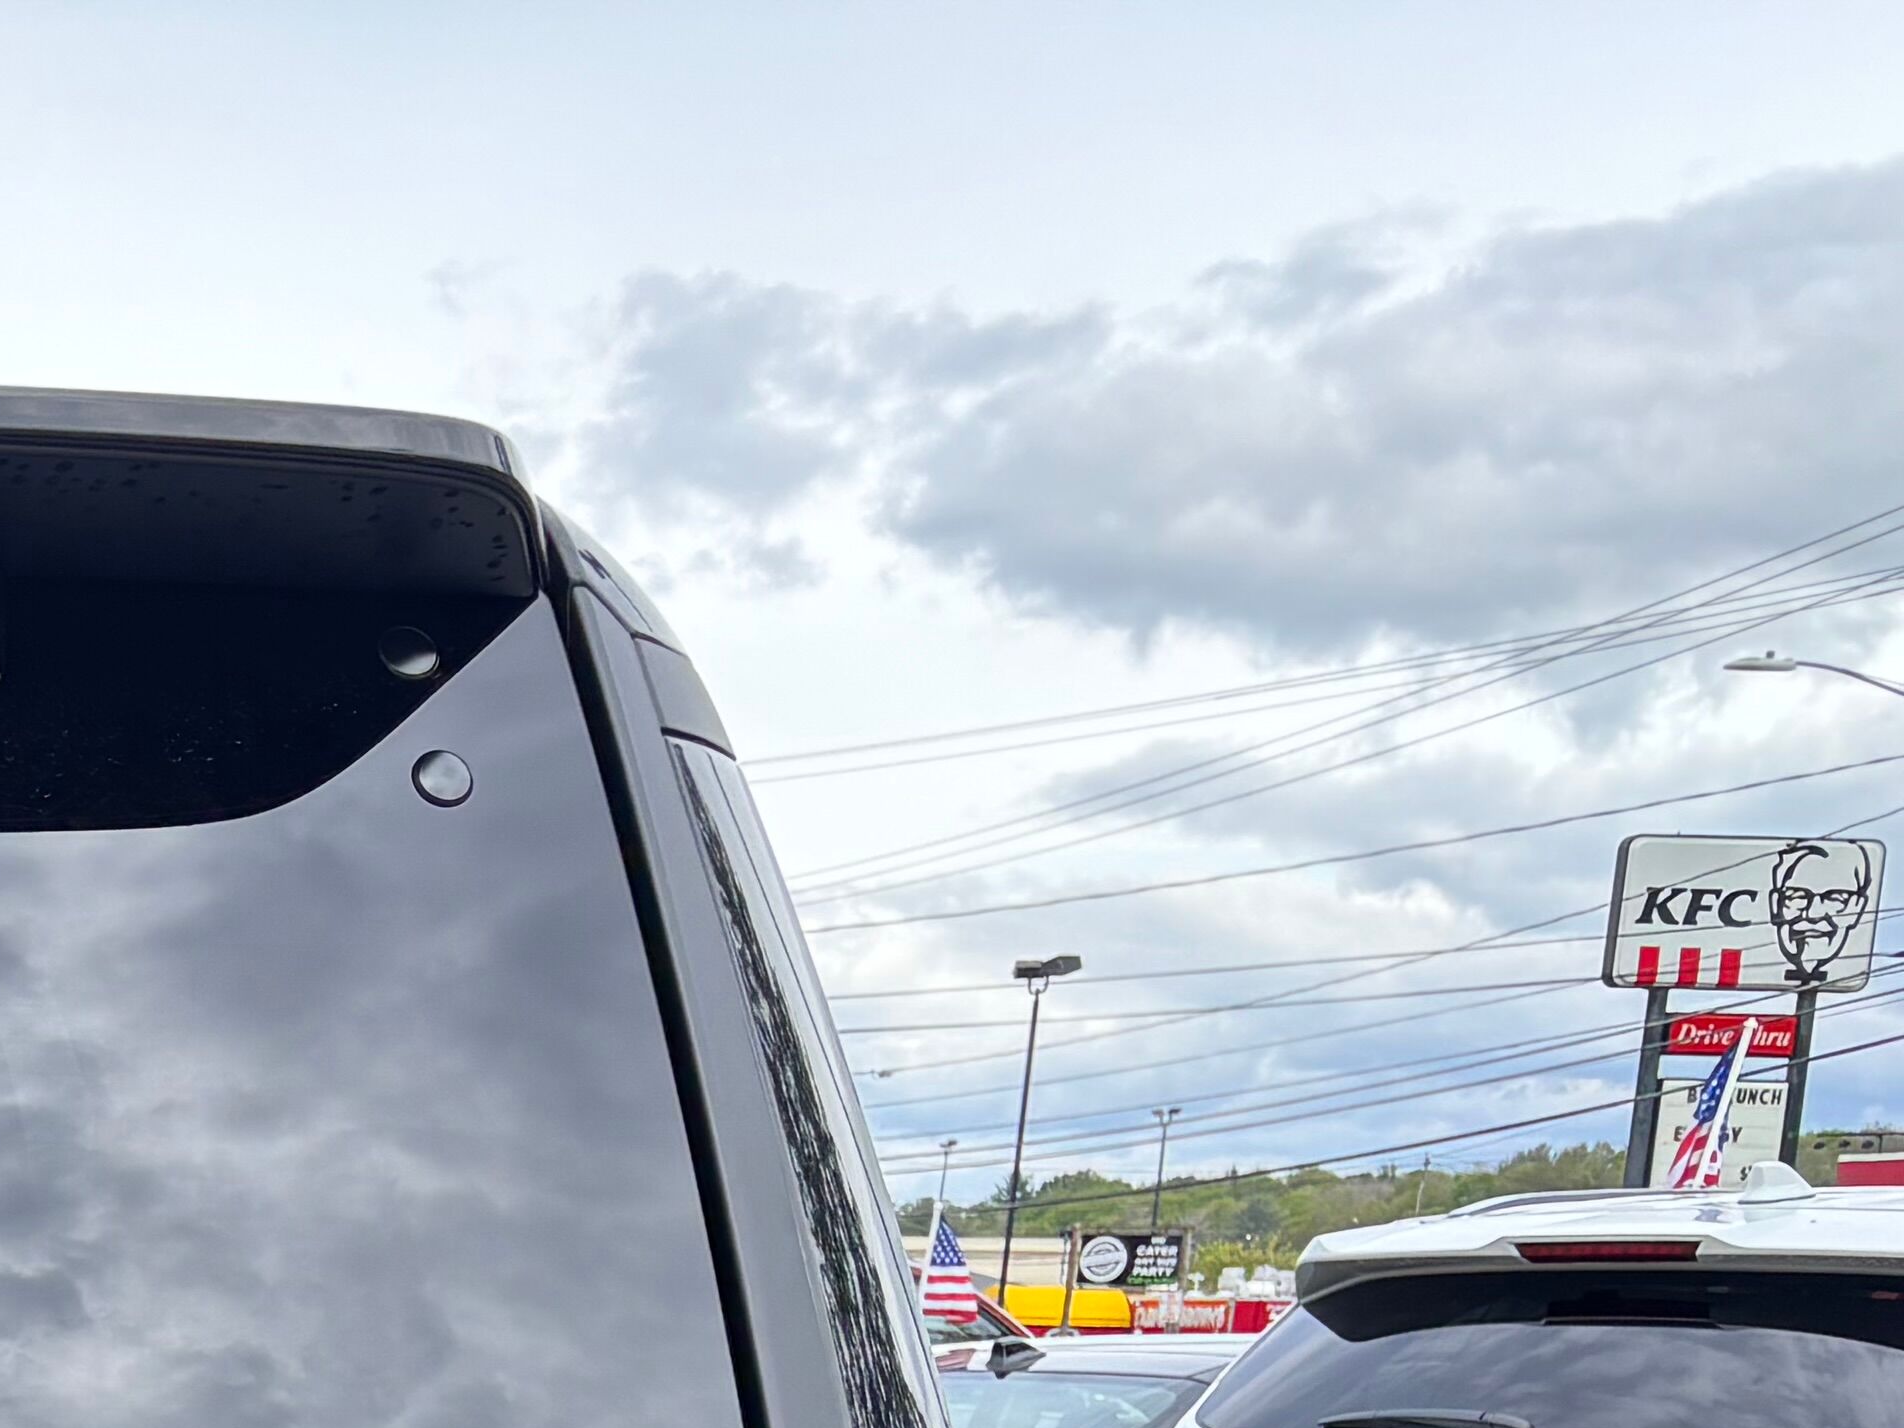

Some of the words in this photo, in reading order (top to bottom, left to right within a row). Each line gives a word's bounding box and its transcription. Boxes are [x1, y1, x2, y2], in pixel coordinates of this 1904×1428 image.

[1635, 886, 1759, 927] KFC
[1677, 1022, 1734, 1045] Drive
[1750, 1024, 1792, 1047] hru
